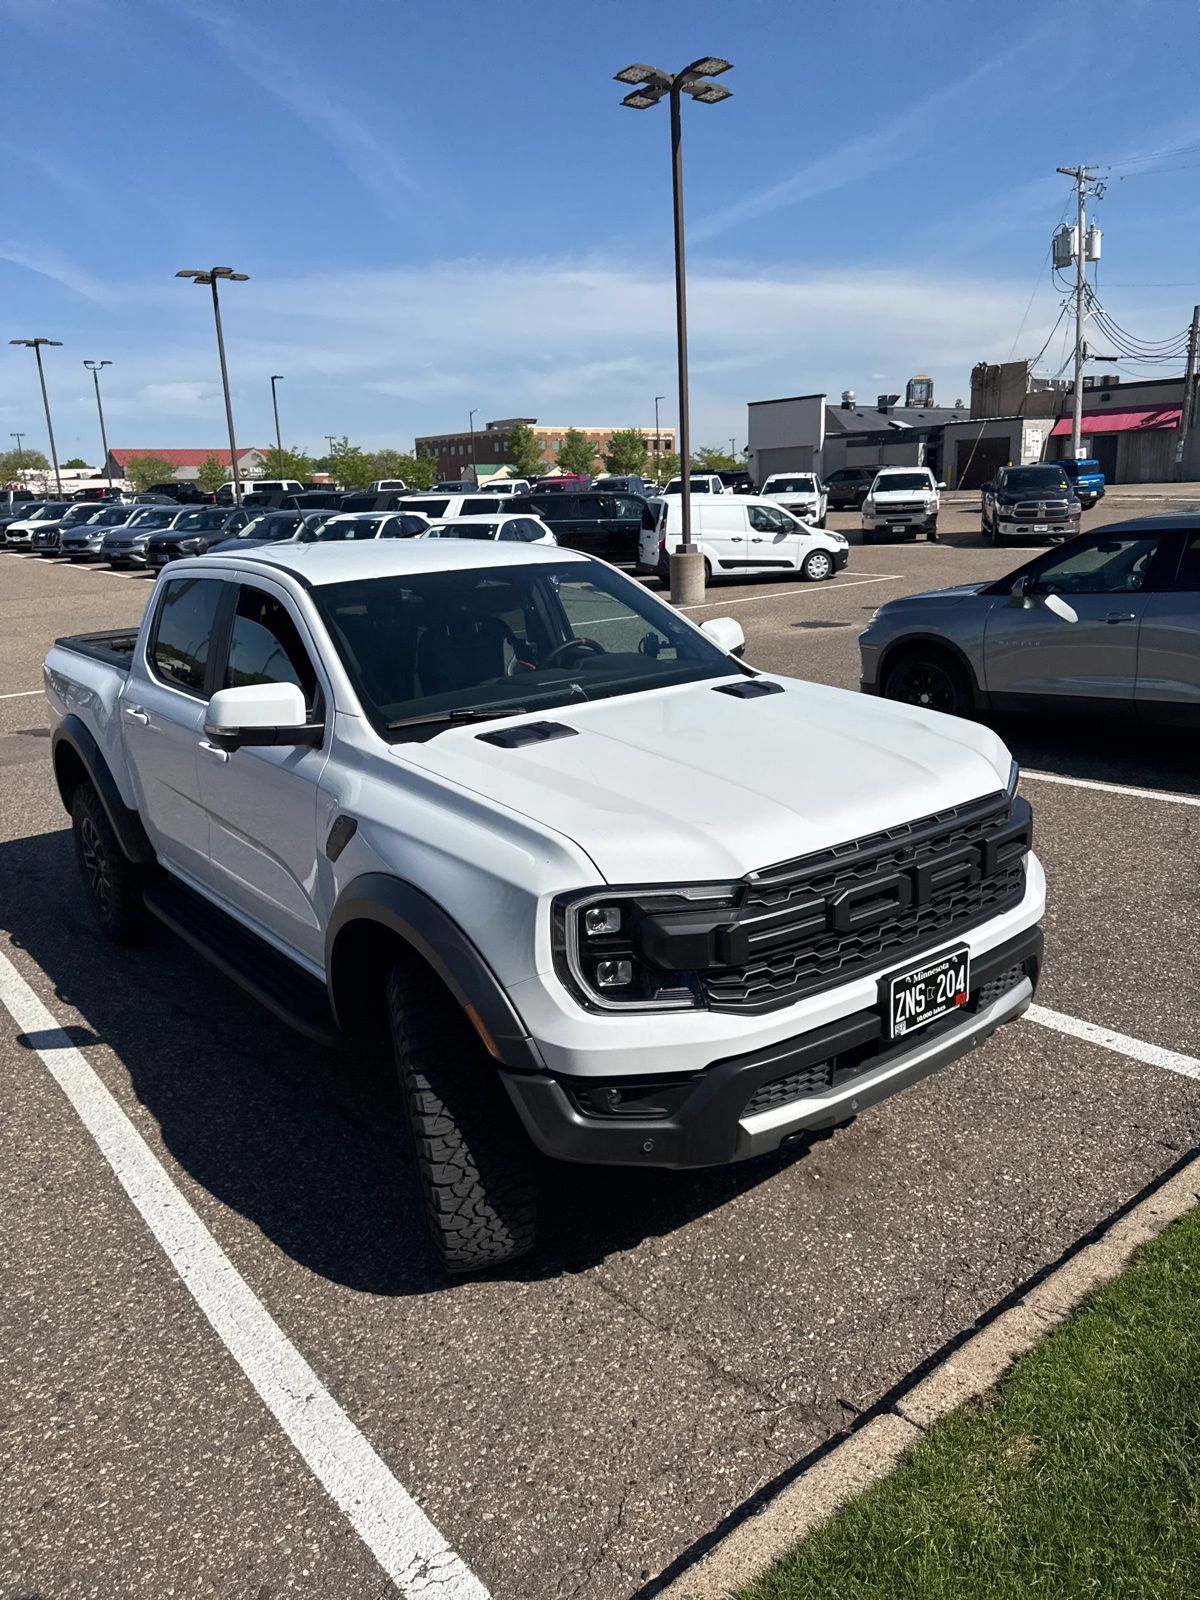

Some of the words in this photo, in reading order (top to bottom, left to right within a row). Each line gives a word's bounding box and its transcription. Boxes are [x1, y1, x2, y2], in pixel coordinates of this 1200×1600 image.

[713, 815, 1033, 966] FORD
[896, 983, 925, 1022] ZNS
[937, 965, 965, 1003] 204
[913, 963, 949, 983] Minnesota
